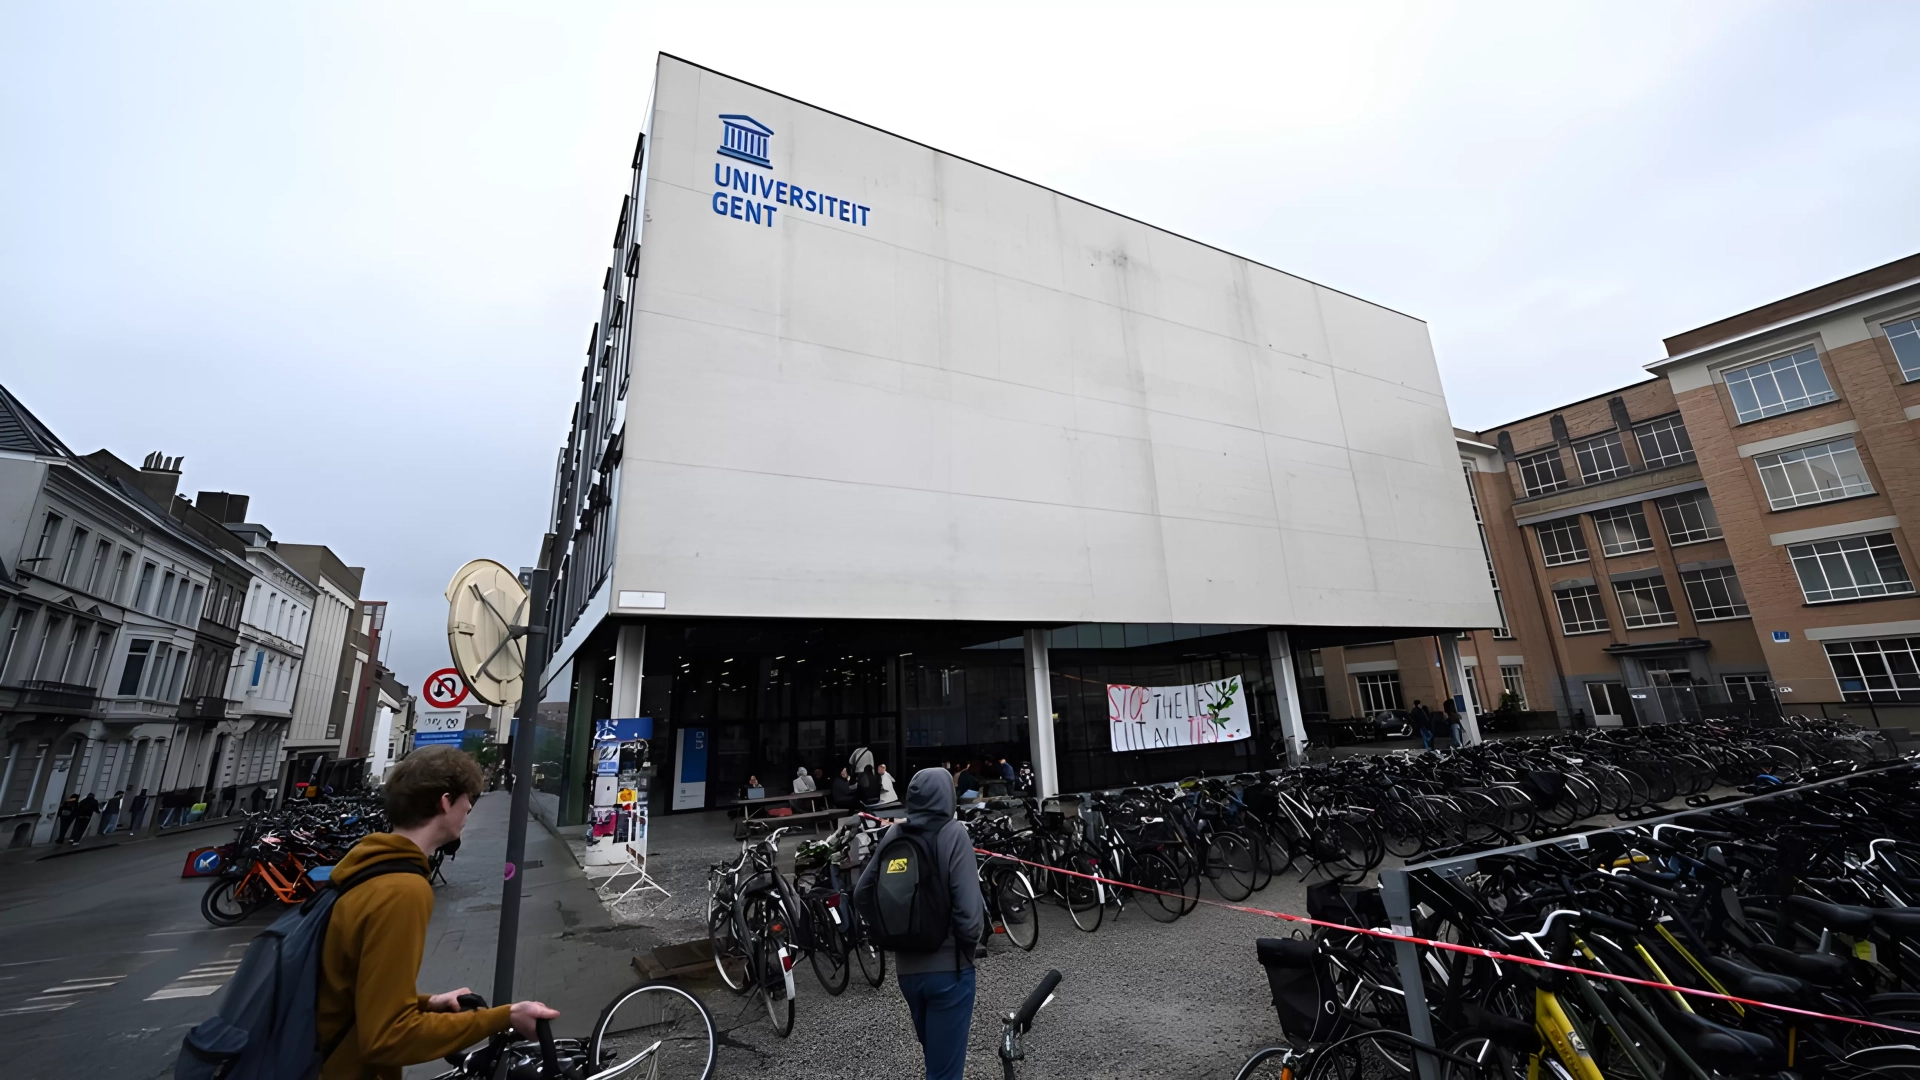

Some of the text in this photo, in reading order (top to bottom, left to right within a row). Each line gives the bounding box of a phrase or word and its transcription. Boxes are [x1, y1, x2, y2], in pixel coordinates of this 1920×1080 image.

[712, 192, 777, 227] GENT
[714, 163, 870, 226] UNIVERSITEIT
[1107, 684, 1150, 721] STOP
[1153, 692, 1182, 719] THE
